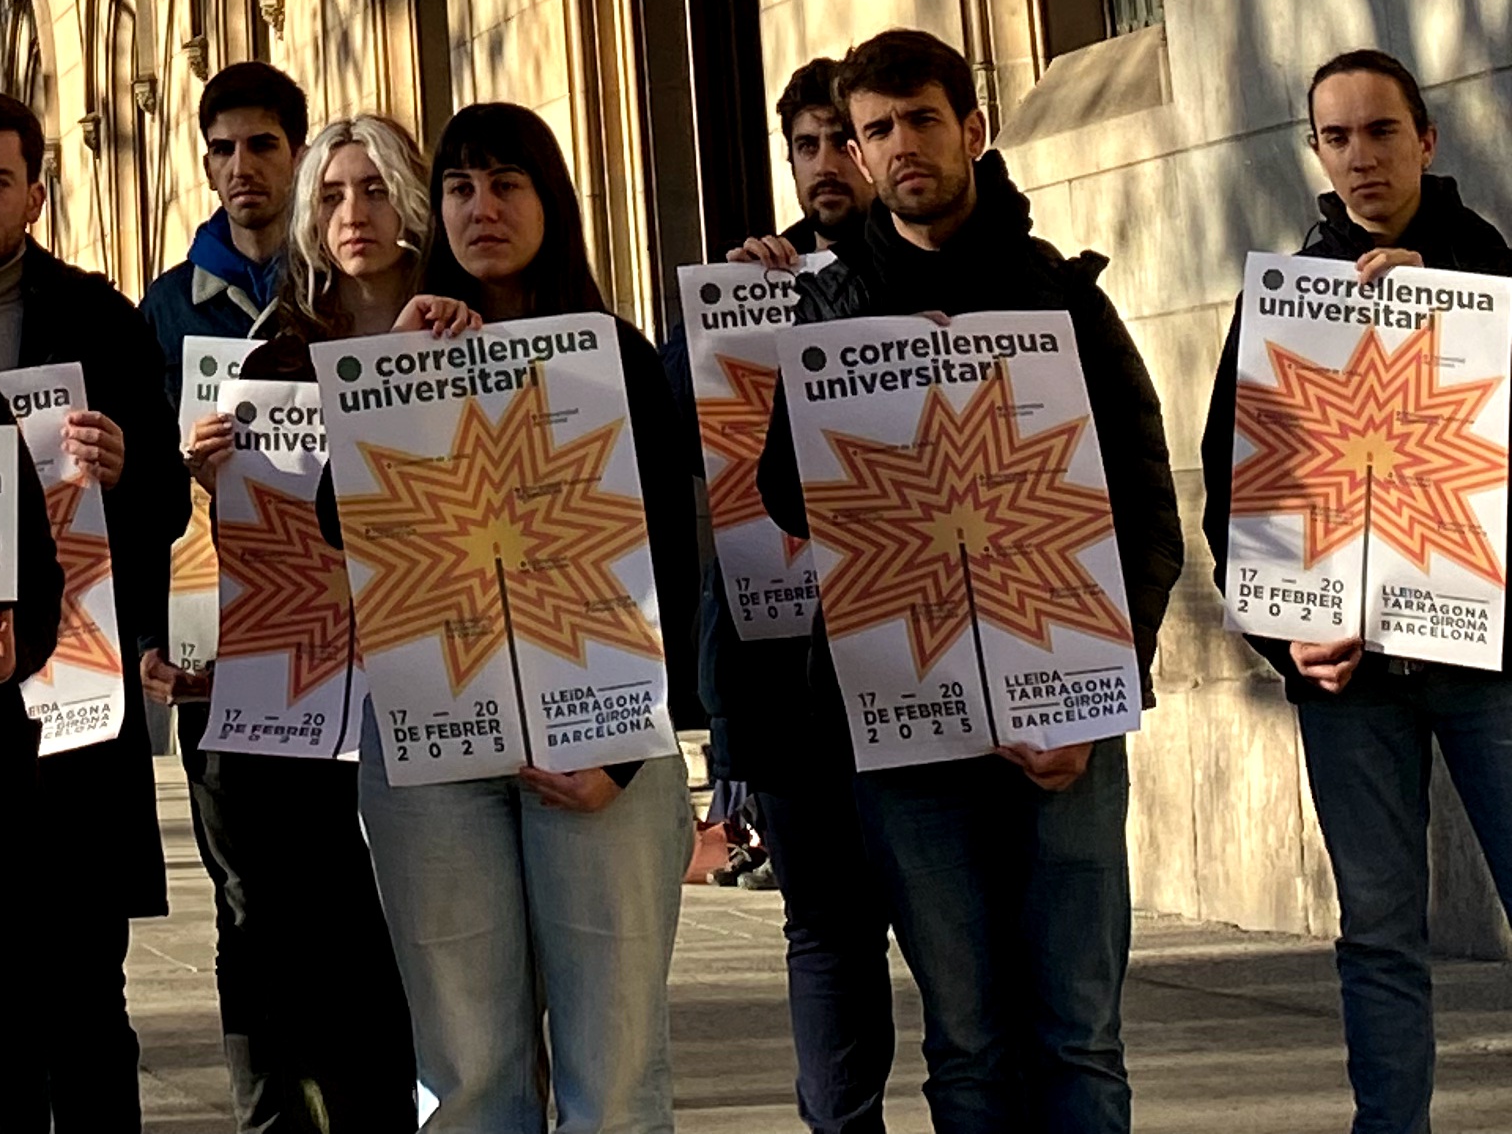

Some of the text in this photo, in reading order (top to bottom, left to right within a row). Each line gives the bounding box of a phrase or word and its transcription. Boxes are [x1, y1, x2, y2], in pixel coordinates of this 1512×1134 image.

[1295, 275, 1494, 312] correllengua
[701, 304, 795, 330] univer
[1259, 295, 1435, 331] universitari
[375, 330, 598, 378] correllengua
[840, 330, 1059, 367] correllengua
[339, 358, 538, 413] universitari
[805, 355, 1002, 402] universitari
[735, 577, 750, 592] 17
[1239, 567, 1258, 583] 17
[1320, 577, 1344, 594] 20
[1382, 584, 1434, 602] LLEIDA
[739, 592, 760, 606] DE
[1239, 584, 1343, 610] DE FEBRER
[1381, 596, 1489, 621] TARRAGONA
[1380, 620, 1488, 645] BARCELONA
[1430, 615, 1488, 632] GIRONA
[181, 643, 195, 657] 17
[1004, 669, 1063, 687] LLEIDA
[1006, 676, 1126, 702] TARRAGONA
[541, 686, 596, 705] LLEIDA
[543, 691, 652, 720] TARRAGONA
[857, 692, 876, 707] 17
[939, 681, 963, 699] 20
[1063, 689, 1127, 708] GIRONA
[28, 702, 60, 717] EIDA
[44, 703, 111, 723] RAGONA
[225, 709, 241, 722] 17
[303, 713, 325, 727] 20
[389, 710, 407, 725] 17
[474, 700, 498, 718] 20
[594, 704, 652, 725] GIRONA
[863, 700, 968, 726] DE FEBRER
[1011, 702, 1128, 729] BARCELONA
[44, 721, 108, 739] CELONA
[251, 723, 322, 738] FEBRER
[394, 719, 502, 743] DE FEBRER
[548, 717, 655, 747] BARCELONA
